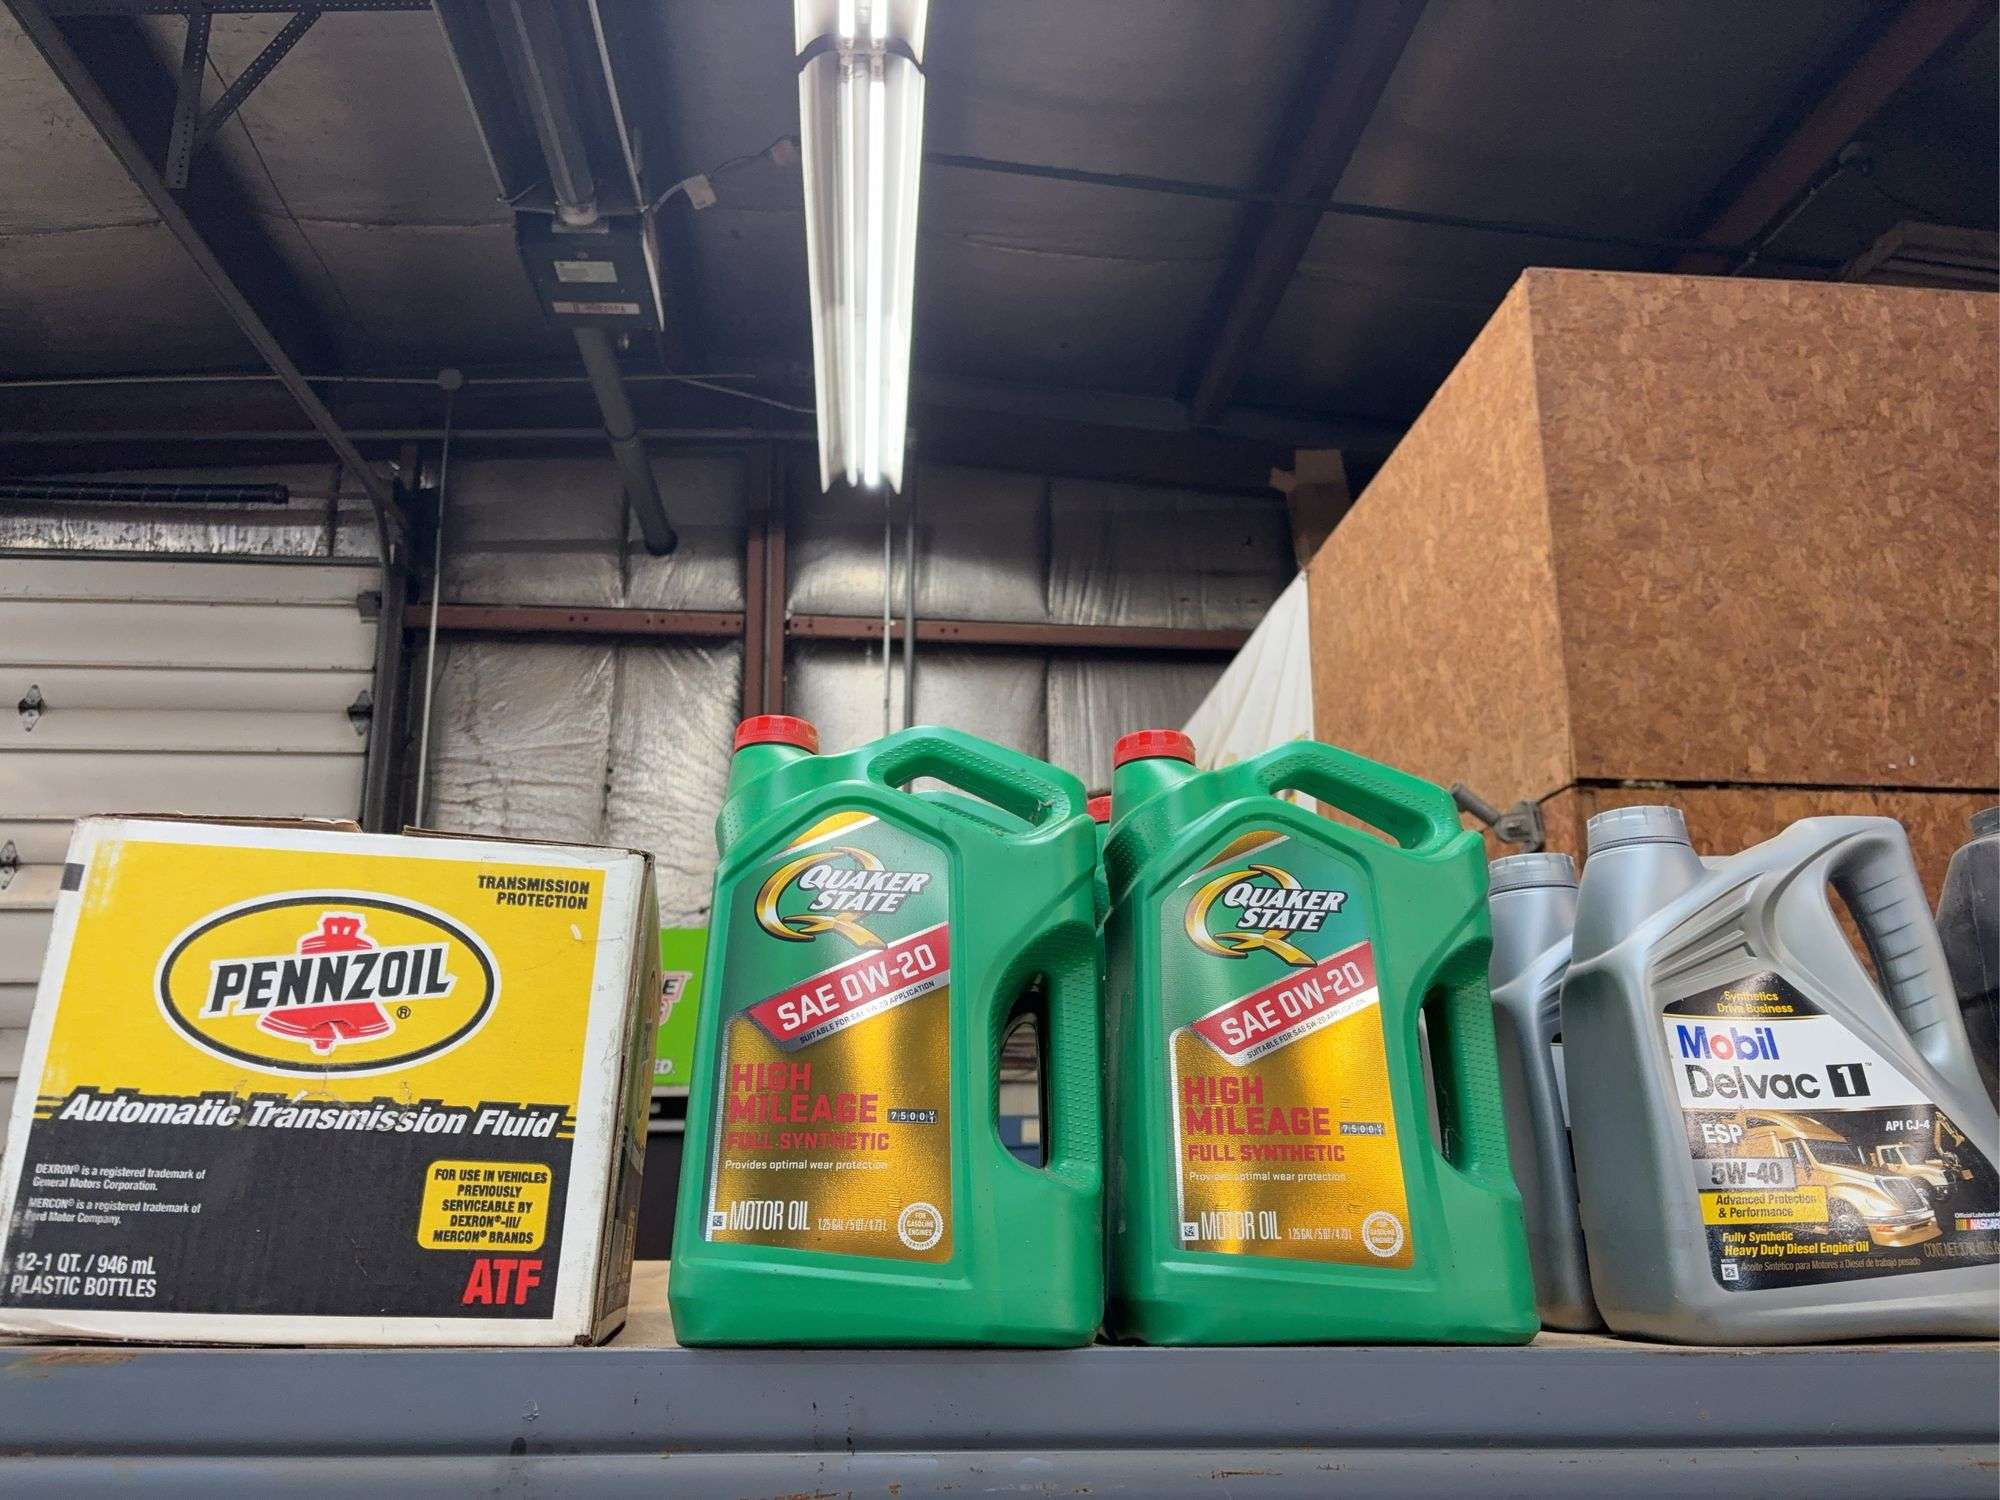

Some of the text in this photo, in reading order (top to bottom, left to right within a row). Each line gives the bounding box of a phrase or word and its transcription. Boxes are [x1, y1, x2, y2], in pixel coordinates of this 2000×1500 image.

[477, 874, 591, 895] TRANSMISSION
[799, 863, 930, 892] QUAKER
[496, 891, 588, 910] PROTECTION
[809, 889, 906, 912] STATE
[1224, 882, 1347, 911] QUAKER
[1237, 907, 1326, 931] STATE
[208, 947, 451, 1013] PENNZOIL
[777, 943, 937, 1032] SAE 0W-20
[1220, 961, 1365, 1046] SAE 0W-20
[1723, 990, 1779, 1002] Synthetics
[800, 1021, 835, 1044] SUITABLE
[835, 1016, 850, 1028] FOR
[889, 981, 936, 1005] APPLICATION
[1746, 1003, 1794, 1014] Business
[1247, 1036, 1279, 1059] SUITABLE
[1279, 1032, 1293, 1044] FOR
[1676, 1024, 1780, 1061] Mobil
[732, 1062, 813, 1092] HIGH
[1685, 1064, 1821, 1100] Delvac
[1184, 1075, 1264, 1105] HIGH
[59, 1093, 559, 1138] Automatic Transmission Fluid
[728, 1093, 878, 1124] MILEAGE
[1185, 1106, 1331, 1136] MILEAGE
[1885, 1119, 1931, 1132] API CJ-4
[725, 1132, 890, 1151] FULL SYNTHETIC
[1701, 1123, 1744, 1144] ESP
[1188, 1144, 1346, 1162] FULL SYNTHETIC
[82, 1166, 91, 1176] is
[91, 1168, 98, 1176] a
[99, 1167, 145, 1179] registered
[147, 1168, 194, 1179] trademark
[196, 1169, 206, 1180] of
[434, 1168, 548, 1184] FOR USE IN VEHICLES
[725, 1159, 767, 1170] Provides
[769, 1160, 808, 1171] optimal
[809, 1162, 833, 1170] wear
[1711, 1161, 1784, 1185] 5W-40
[33, 1176, 158, 1191] General Motors Corporation.
[1273, 1173, 1295, 1181] wear
[457, 1184, 523, 1198] PREVIOUSLY
[1716, 1193, 1817, 1205] Advanced Protection
[76, 1200, 85, 1209] is
[86, 1202, 93, 1210] a
[95, 1201, 141, 1213] registered
[142, 1202, 189, 1213] trademark
[191, 1203, 202, 1214] of
[442, 1199, 533, 1214] SERVICEABLE BY
[729, 1200, 811, 1231] MOTOR OIL
[1718, 1206, 1794, 1218] & Performance
[48, 1211, 76, 1223] Motor
[77, 1213, 122, 1226] Company.
[1259, 1211, 1282, 1240] OIL
[489, 1231, 534, 1244] BRANDS
[1722, 1231, 1794, 1244] Fully Synthetic
[1725, 1240, 1870, 1258] Heavy Duty Diesel Engine Oil
[16, 1252, 157, 1275] 12-1 QT. / 946 mL
[10, 1275, 157, 1298] PLASTIC BOTTLES
[462, 1258, 544, 1305] ATF
